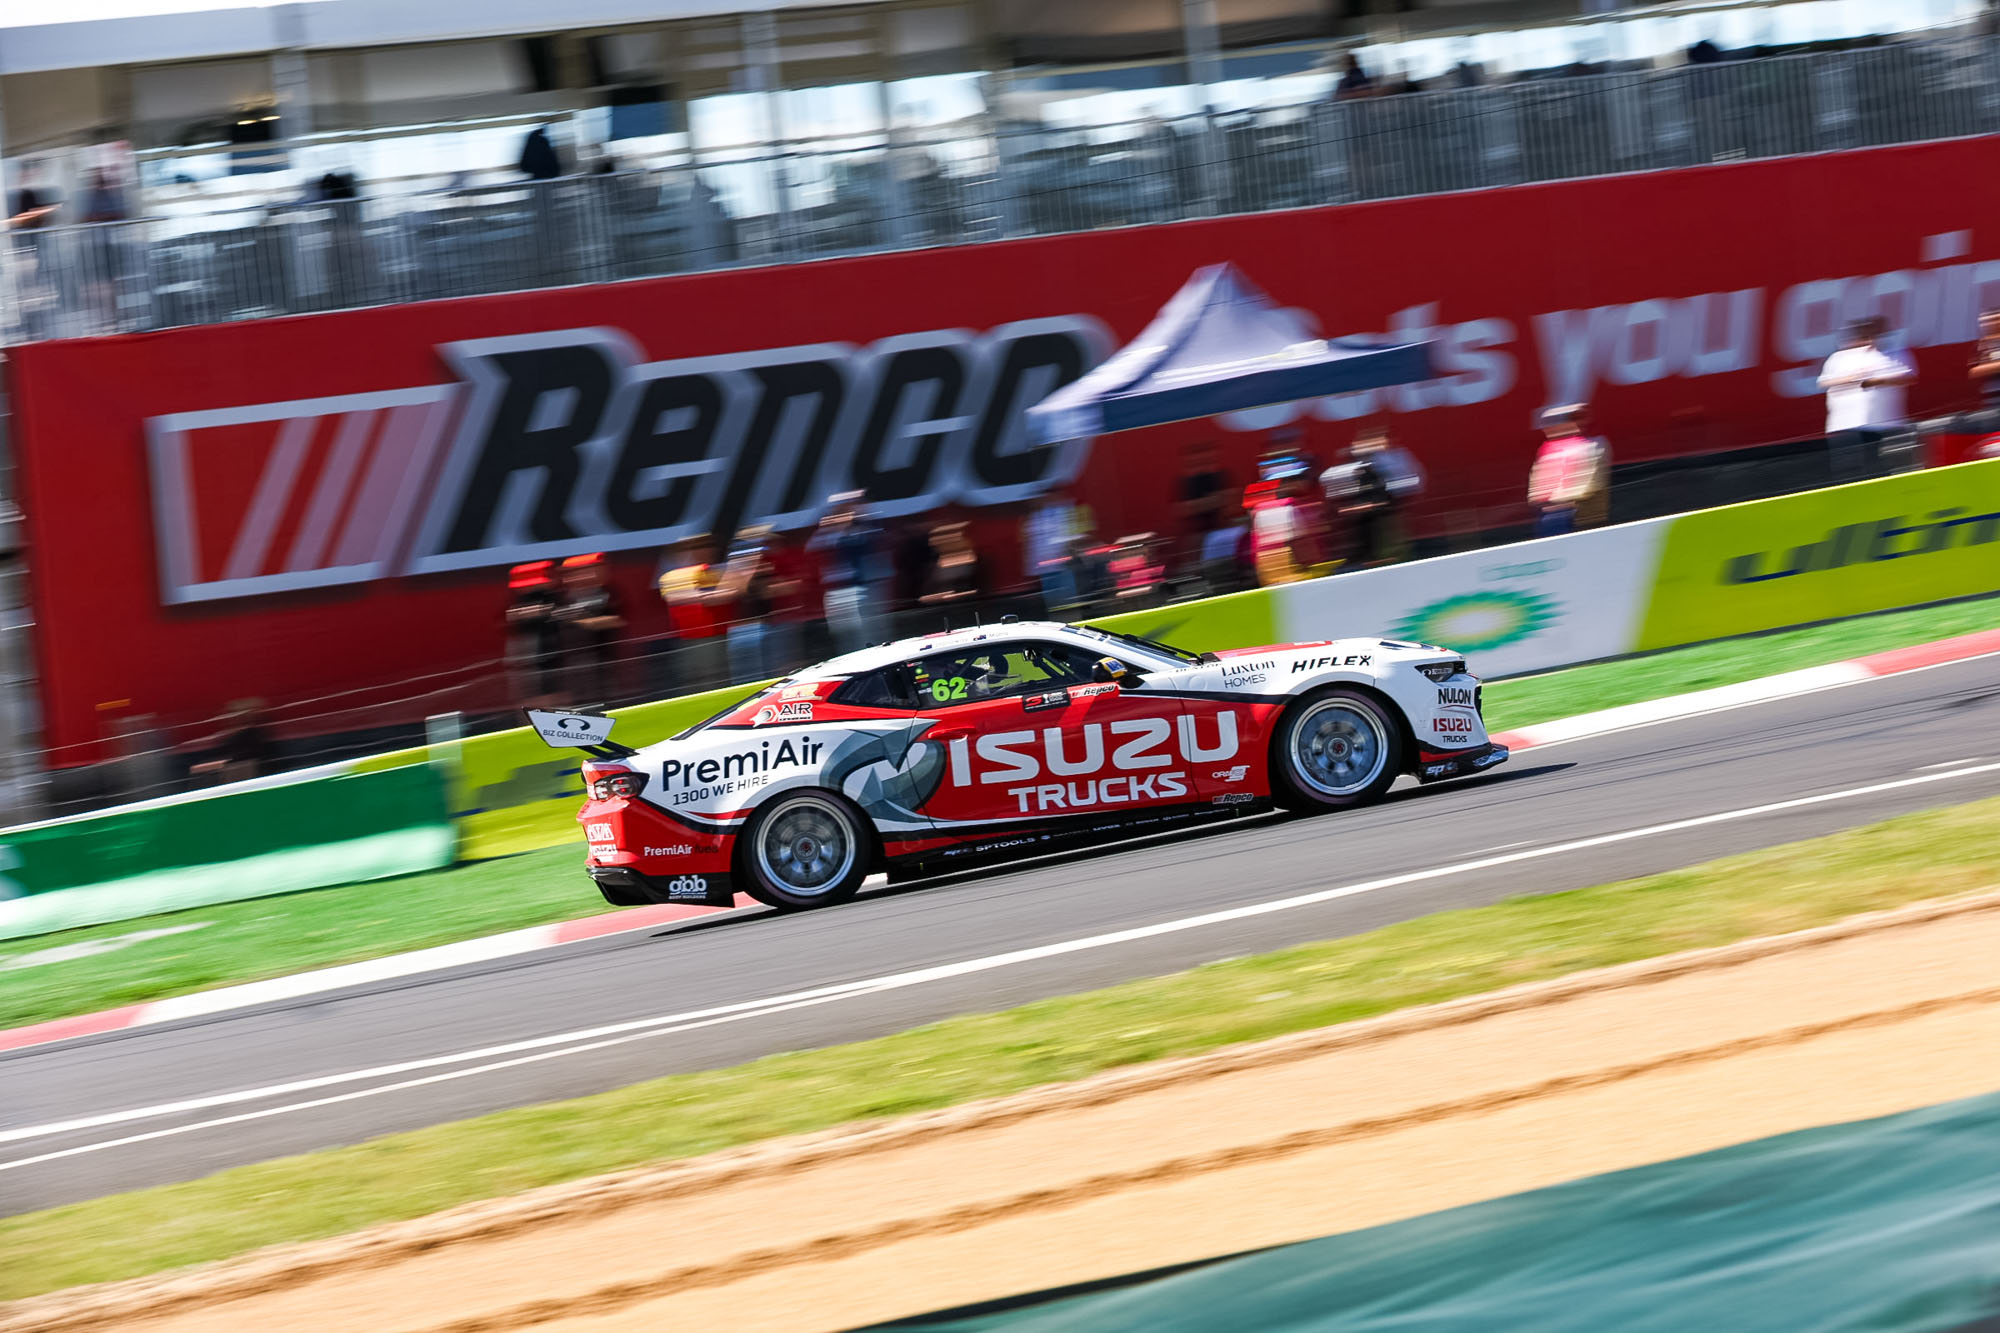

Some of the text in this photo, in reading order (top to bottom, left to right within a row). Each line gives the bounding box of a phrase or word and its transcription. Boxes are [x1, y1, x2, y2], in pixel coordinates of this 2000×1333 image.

[1533, 287, 1768, 404] you
[424, 322, 1098, 545] Repco
[1221, 660, 1275, 676] Luxton
[1291, 655, 1371, 673] HIFLEX
[932, 676, 968, 702] 62
[1224, 674, 1267, 688] HOMES
[1083, 684, 1115, 695] Repco
[1438, 688, 1471, 704] NULON
[780, 703, 812, 715] AIR
[1433, 718, 1472, 732] ISUZU
[543, 729, 603, 742] BIZ COLLECTION
[949, 710, 1239, 787] ISUZU
[662, 736, 823, 791] PremiAir
[673, 775, 769, 806] 1300 WE HIRE
[1008, 771, 1188, 812] TRUCKS
[1224, 793, 1253, 803] Repco
[643, 844, 692, 857] PremiAir
